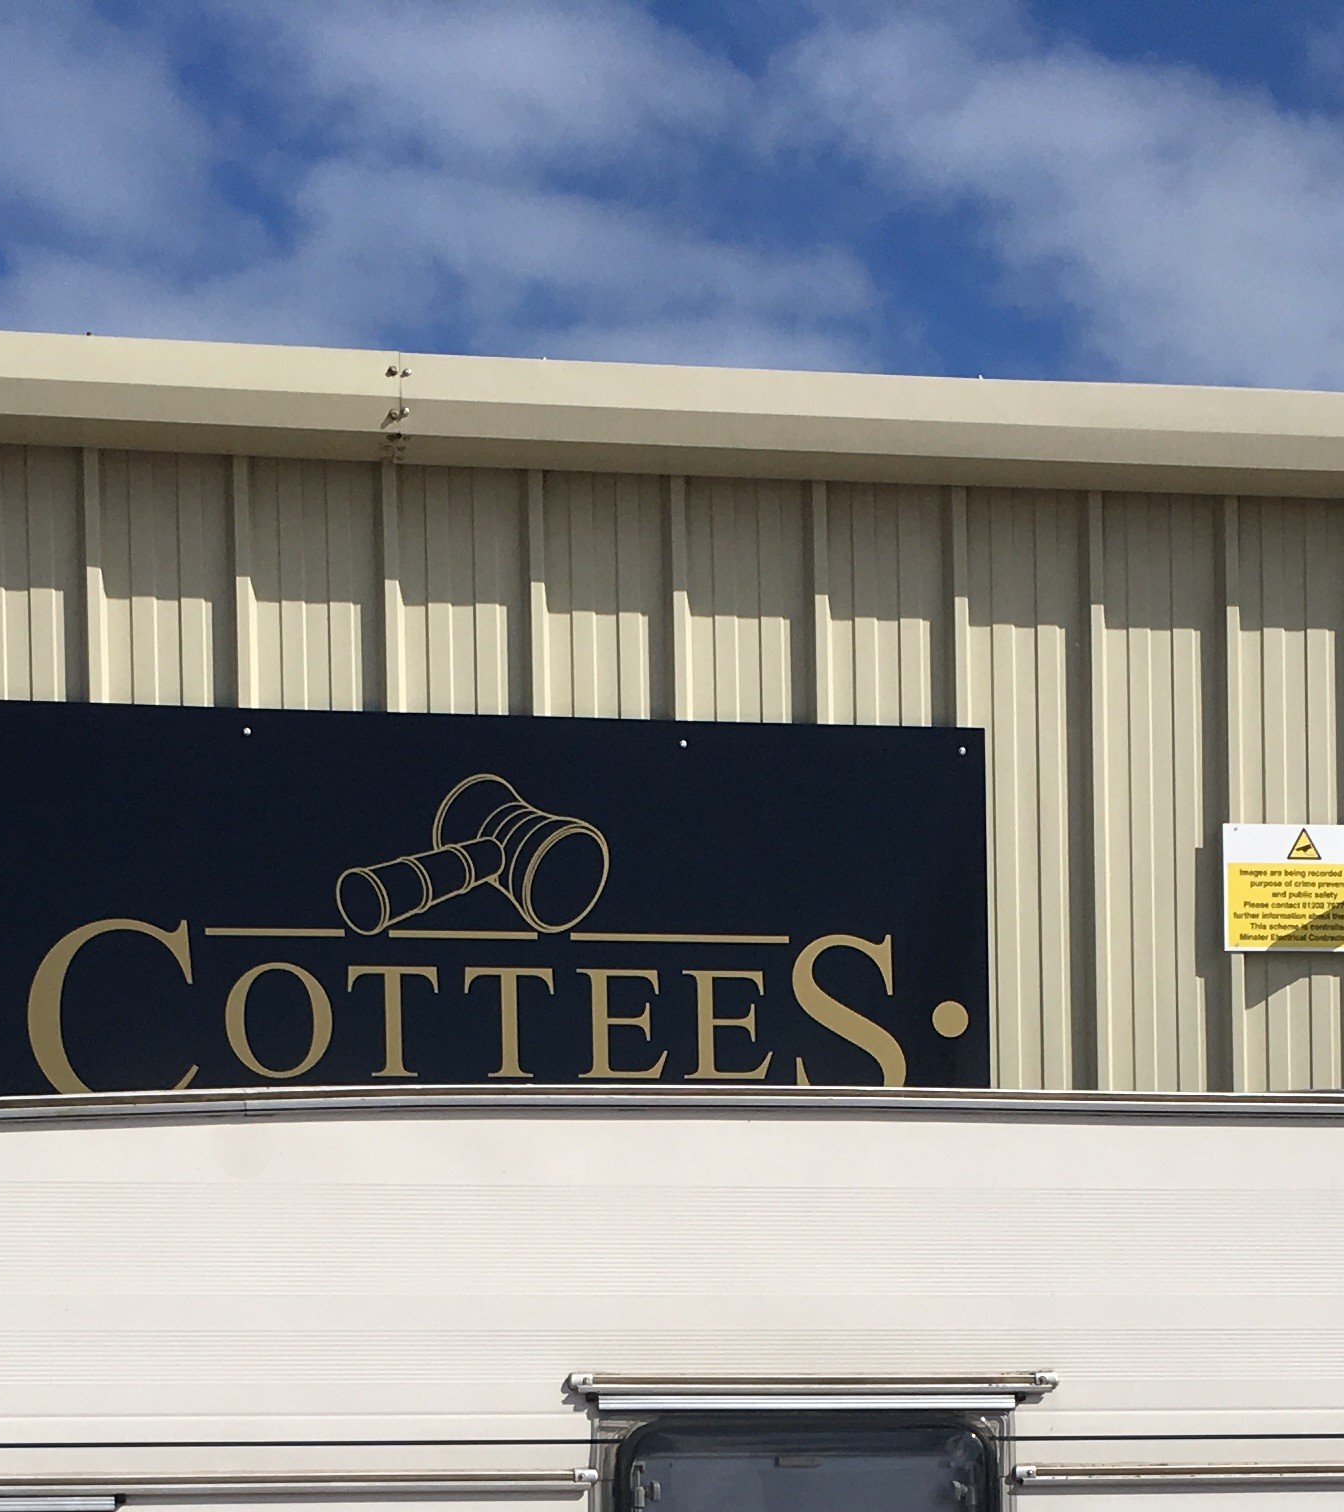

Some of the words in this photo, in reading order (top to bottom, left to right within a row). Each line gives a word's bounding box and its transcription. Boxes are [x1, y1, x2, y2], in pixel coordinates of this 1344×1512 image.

[1239, 869, 1268, 878] Images
[1284, 869, 1306, 878] being
[1307, 870, 1342, 878] recorded
[1249, 881, 1282, 889] purpose
[1284, 880, 1292, 888] of
[1294, 880, 1316, 888] crime
[1288, 891, 1312, 900] public
[1314, 891, 1338, 900] safety
[1233, 912, 1259, 920] further
[1269, 923, 1299, 931] scheme
[1239, 933, 1268, 941] Minster
[1270, 934, 1306, 942] Electrical
